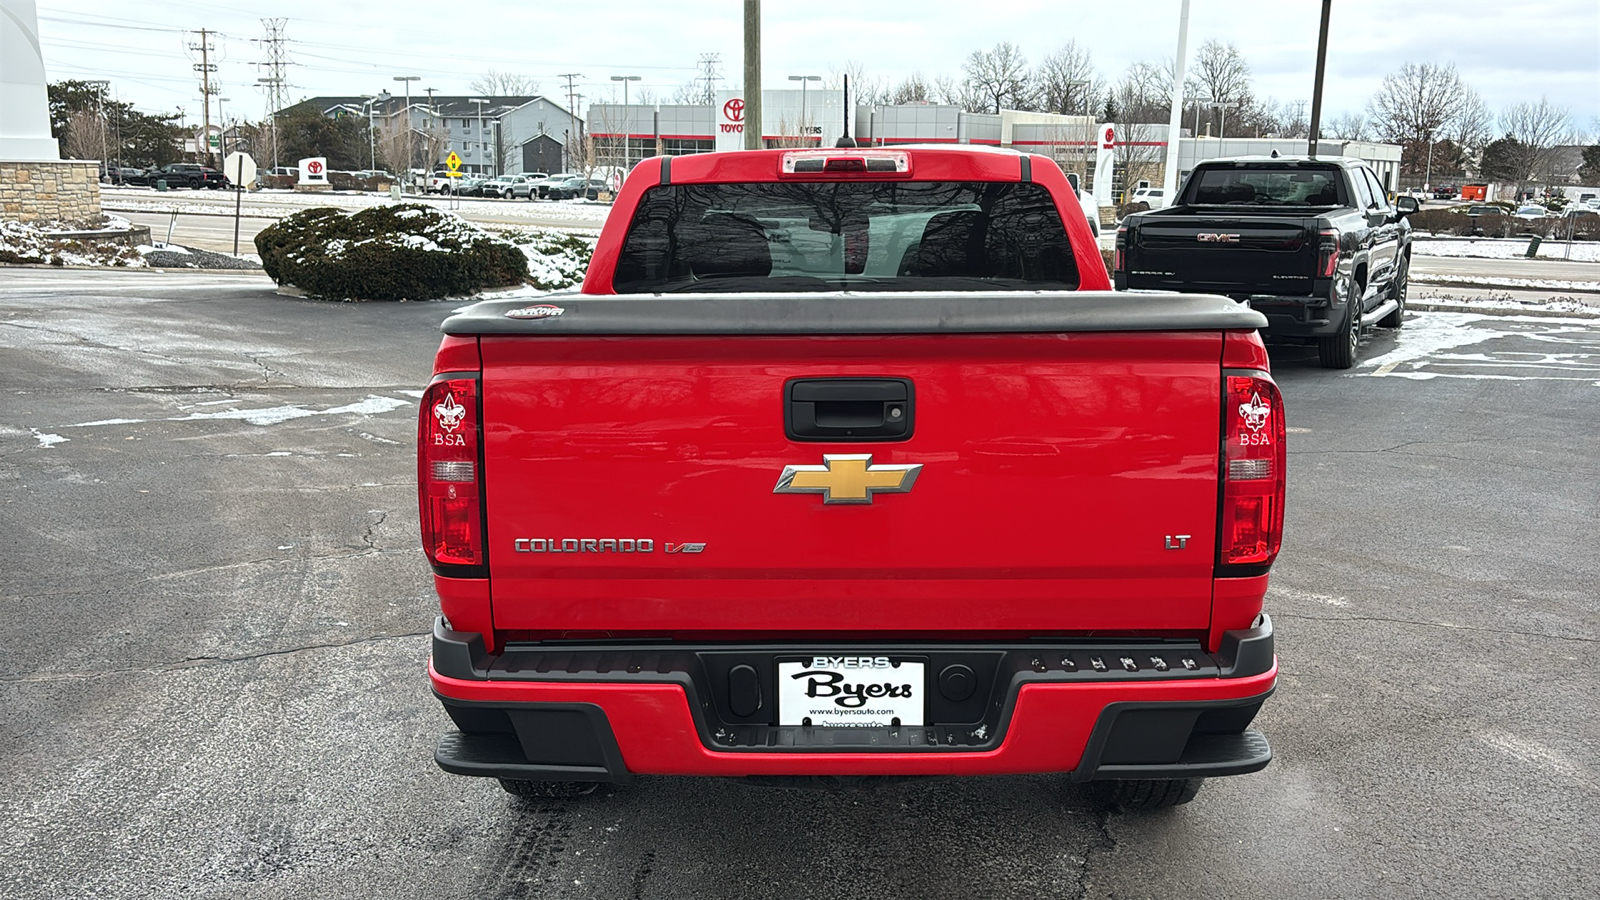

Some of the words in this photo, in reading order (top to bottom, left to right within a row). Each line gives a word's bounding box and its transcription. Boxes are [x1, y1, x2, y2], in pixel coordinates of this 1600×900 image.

[719, 123, 744, 133] TOYO
[1197, 233, 1240, 242] GMC
[434, 433, 466, 446] BSA
[1239, 433, 1271, 446] BSA
[514, 538, 654, 553] COLORADO
[664, 542, 707, 553] V6
[1165, 534, 1192, 549] LT
[812, 656, 891, 669] BYERS
[790, 670, 913, 708] Byers
[809, 707, 894, 716] www.byersauto.com
